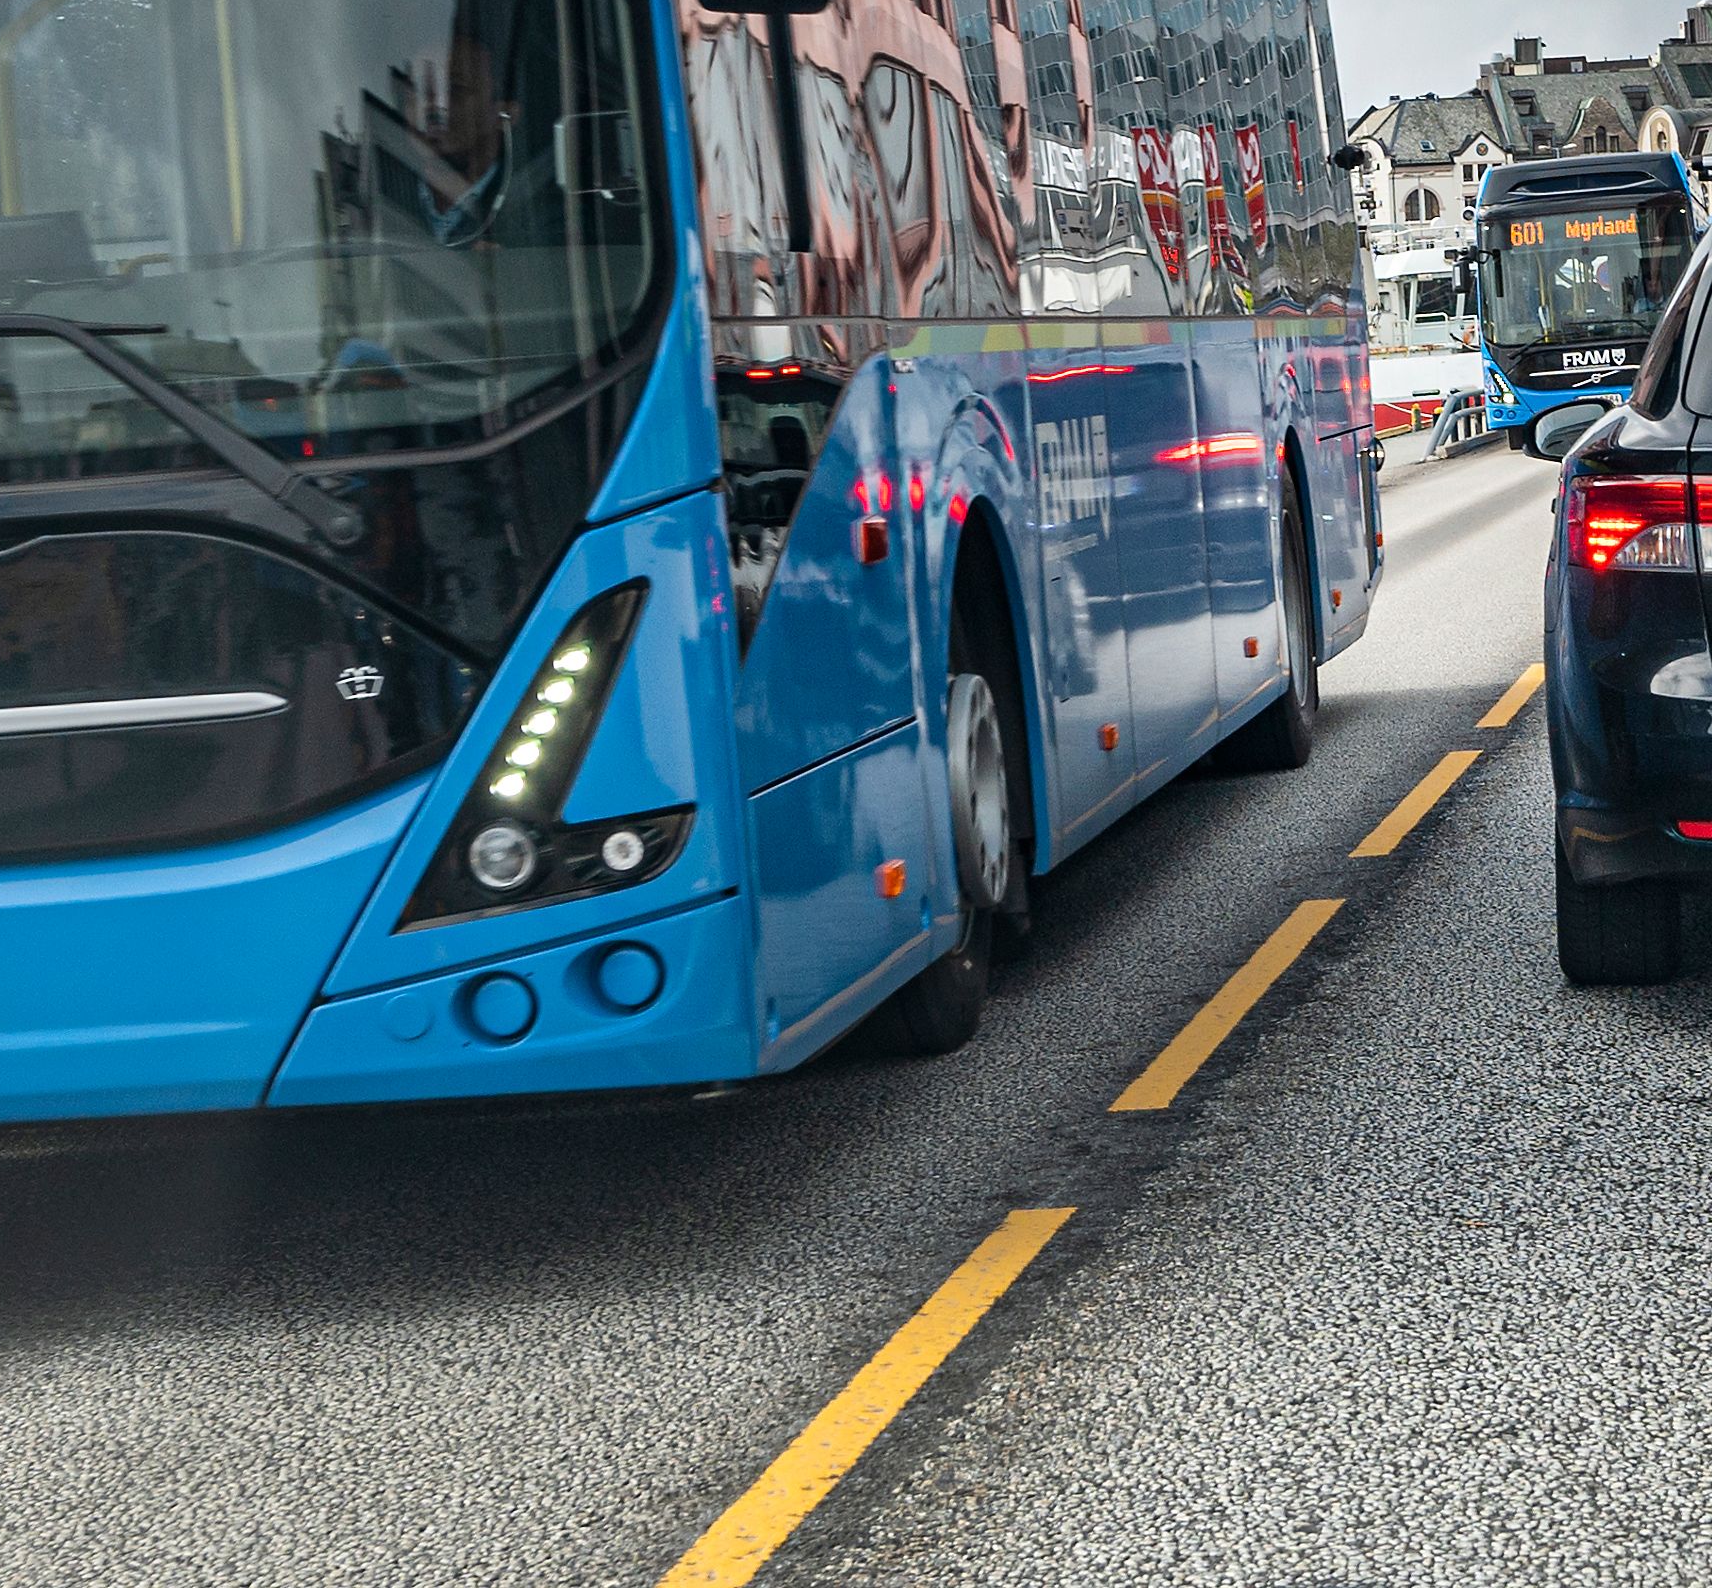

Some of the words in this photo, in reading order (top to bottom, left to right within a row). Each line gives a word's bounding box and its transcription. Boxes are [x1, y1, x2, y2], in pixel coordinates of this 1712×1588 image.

[1510, 221, 1544, 246] 601
[1565, 212, 1637, 242] Myrland
[1562, 349, 1611, 367] FRAM
